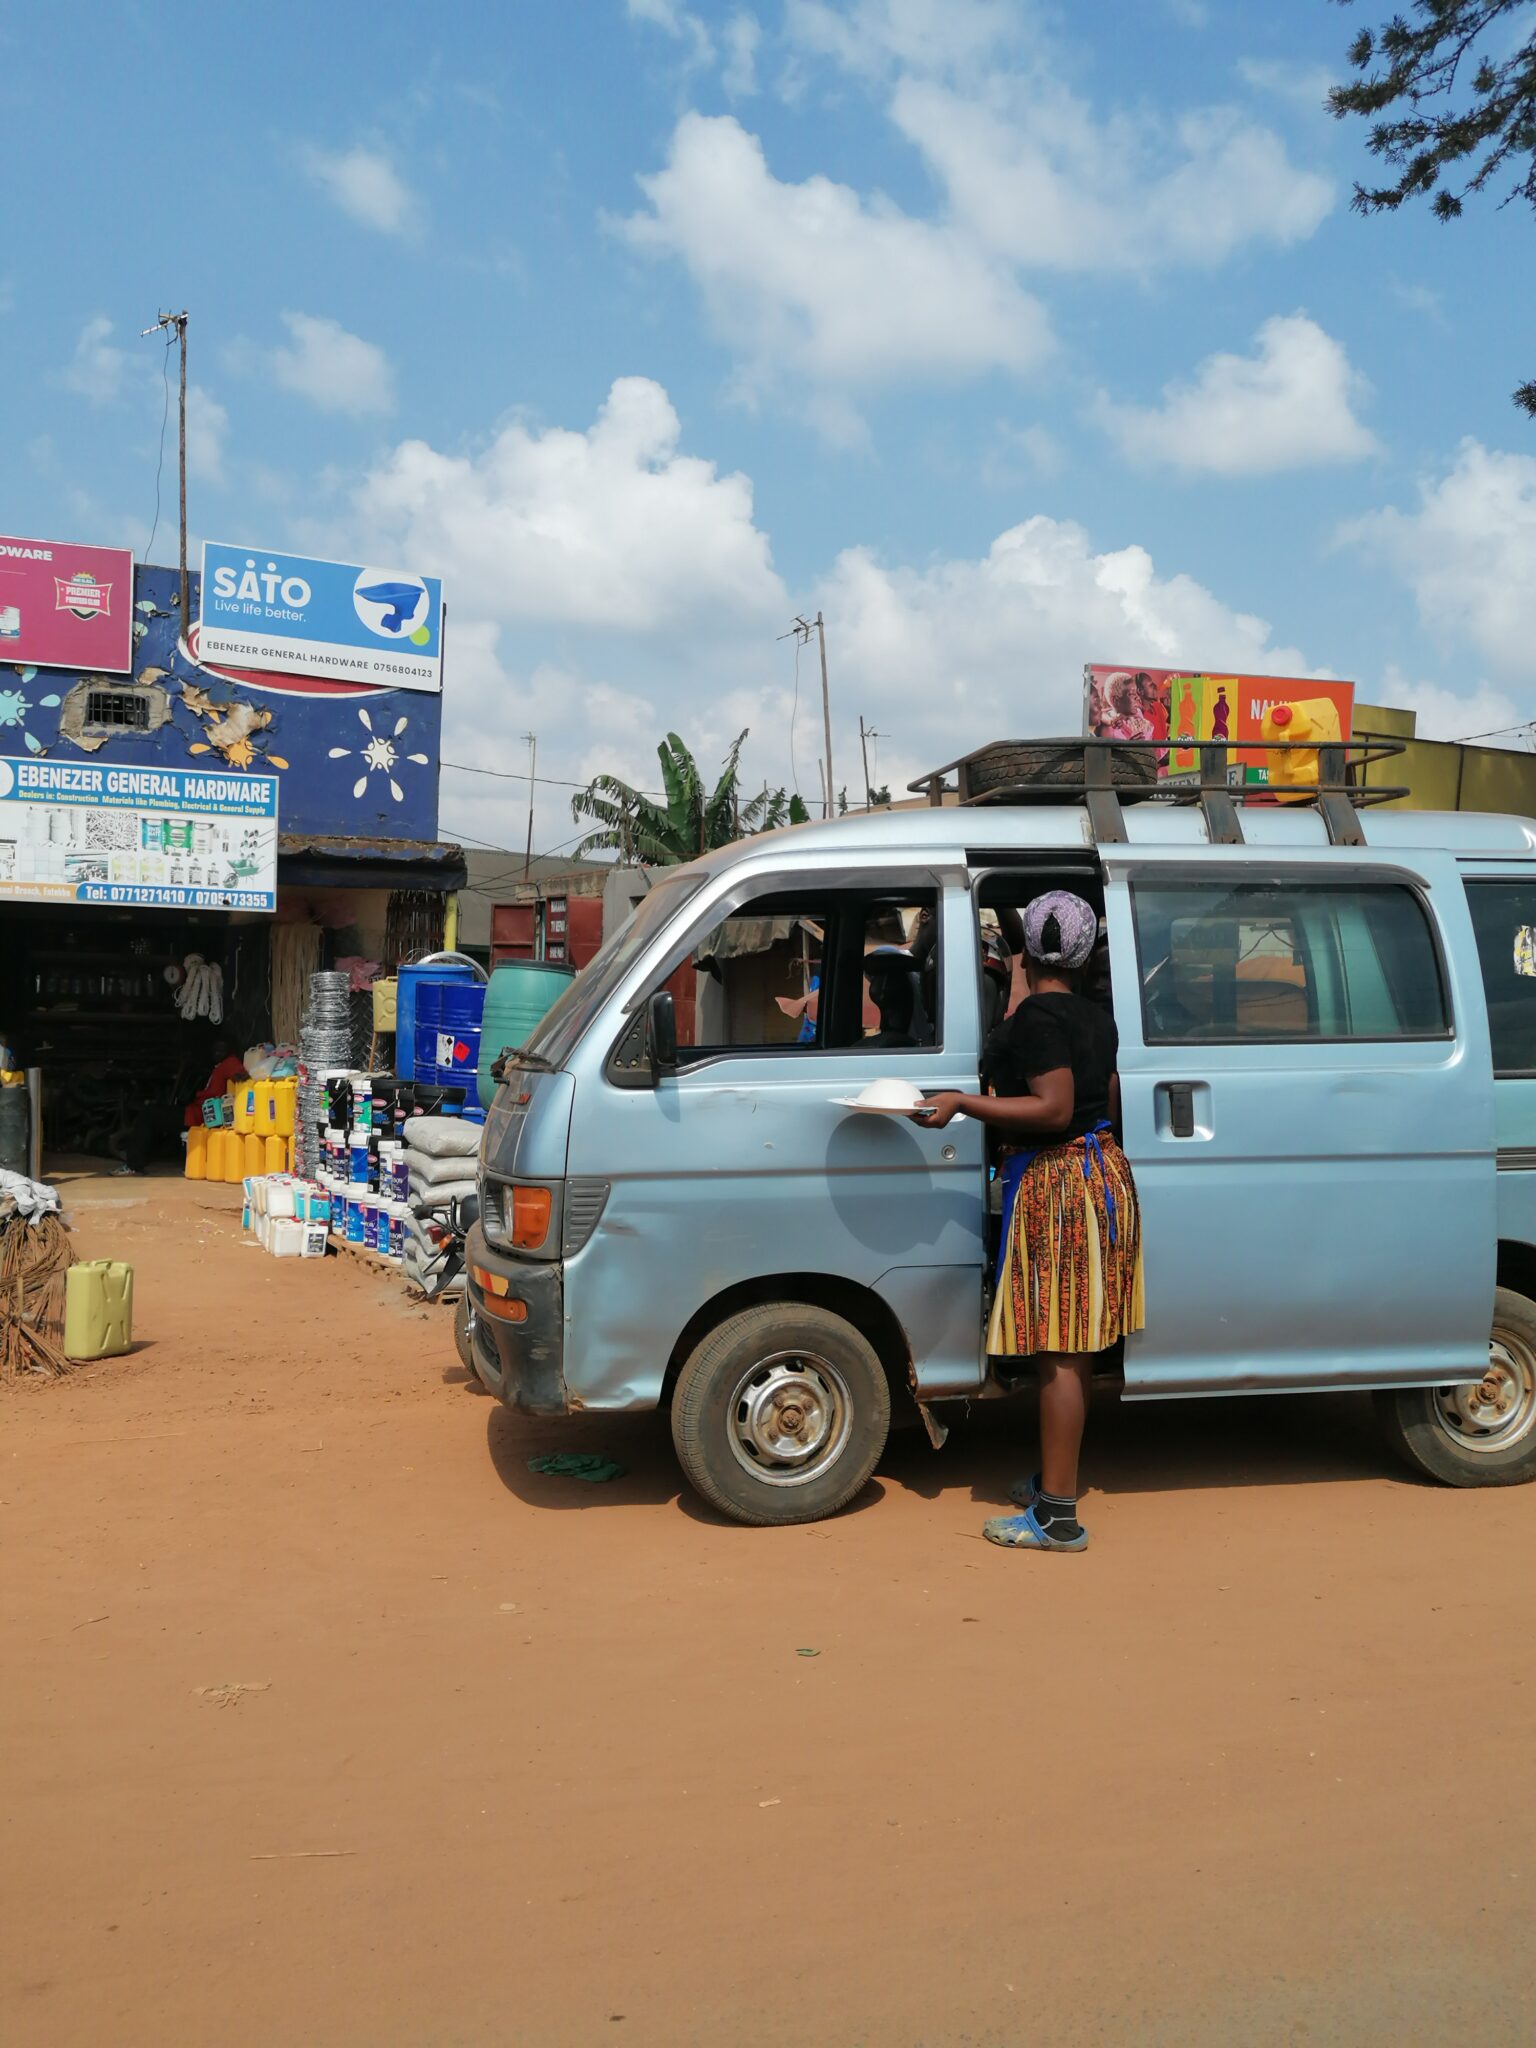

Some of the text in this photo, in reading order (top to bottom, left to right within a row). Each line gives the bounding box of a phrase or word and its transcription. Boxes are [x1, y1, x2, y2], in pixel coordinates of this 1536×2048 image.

[214, 599, 307, 623] Live life better.
[206, 640, 433, 678] EBENEZER GENERAL HARDWARE 0756804123
[19, 766, 270, 804] EBENEZER GENERAL HARDWARE
[19, 790, 44, 798] Dealers
[57, 792, 98, 802] Construction
[102, 795, 134, 806] Materials
[135, 798, 148, 806] like
[149, 799, 180, 810] Plumbing,
[183, 802, 211, 811] Electrical
[213, 803, 218, 811] &
[219, 804, 243, 813] General
[245, 805, 266, 815] Supply
[86, 886, 108, 900] Tel:
[110, 887, 185, 903] 0771271410
